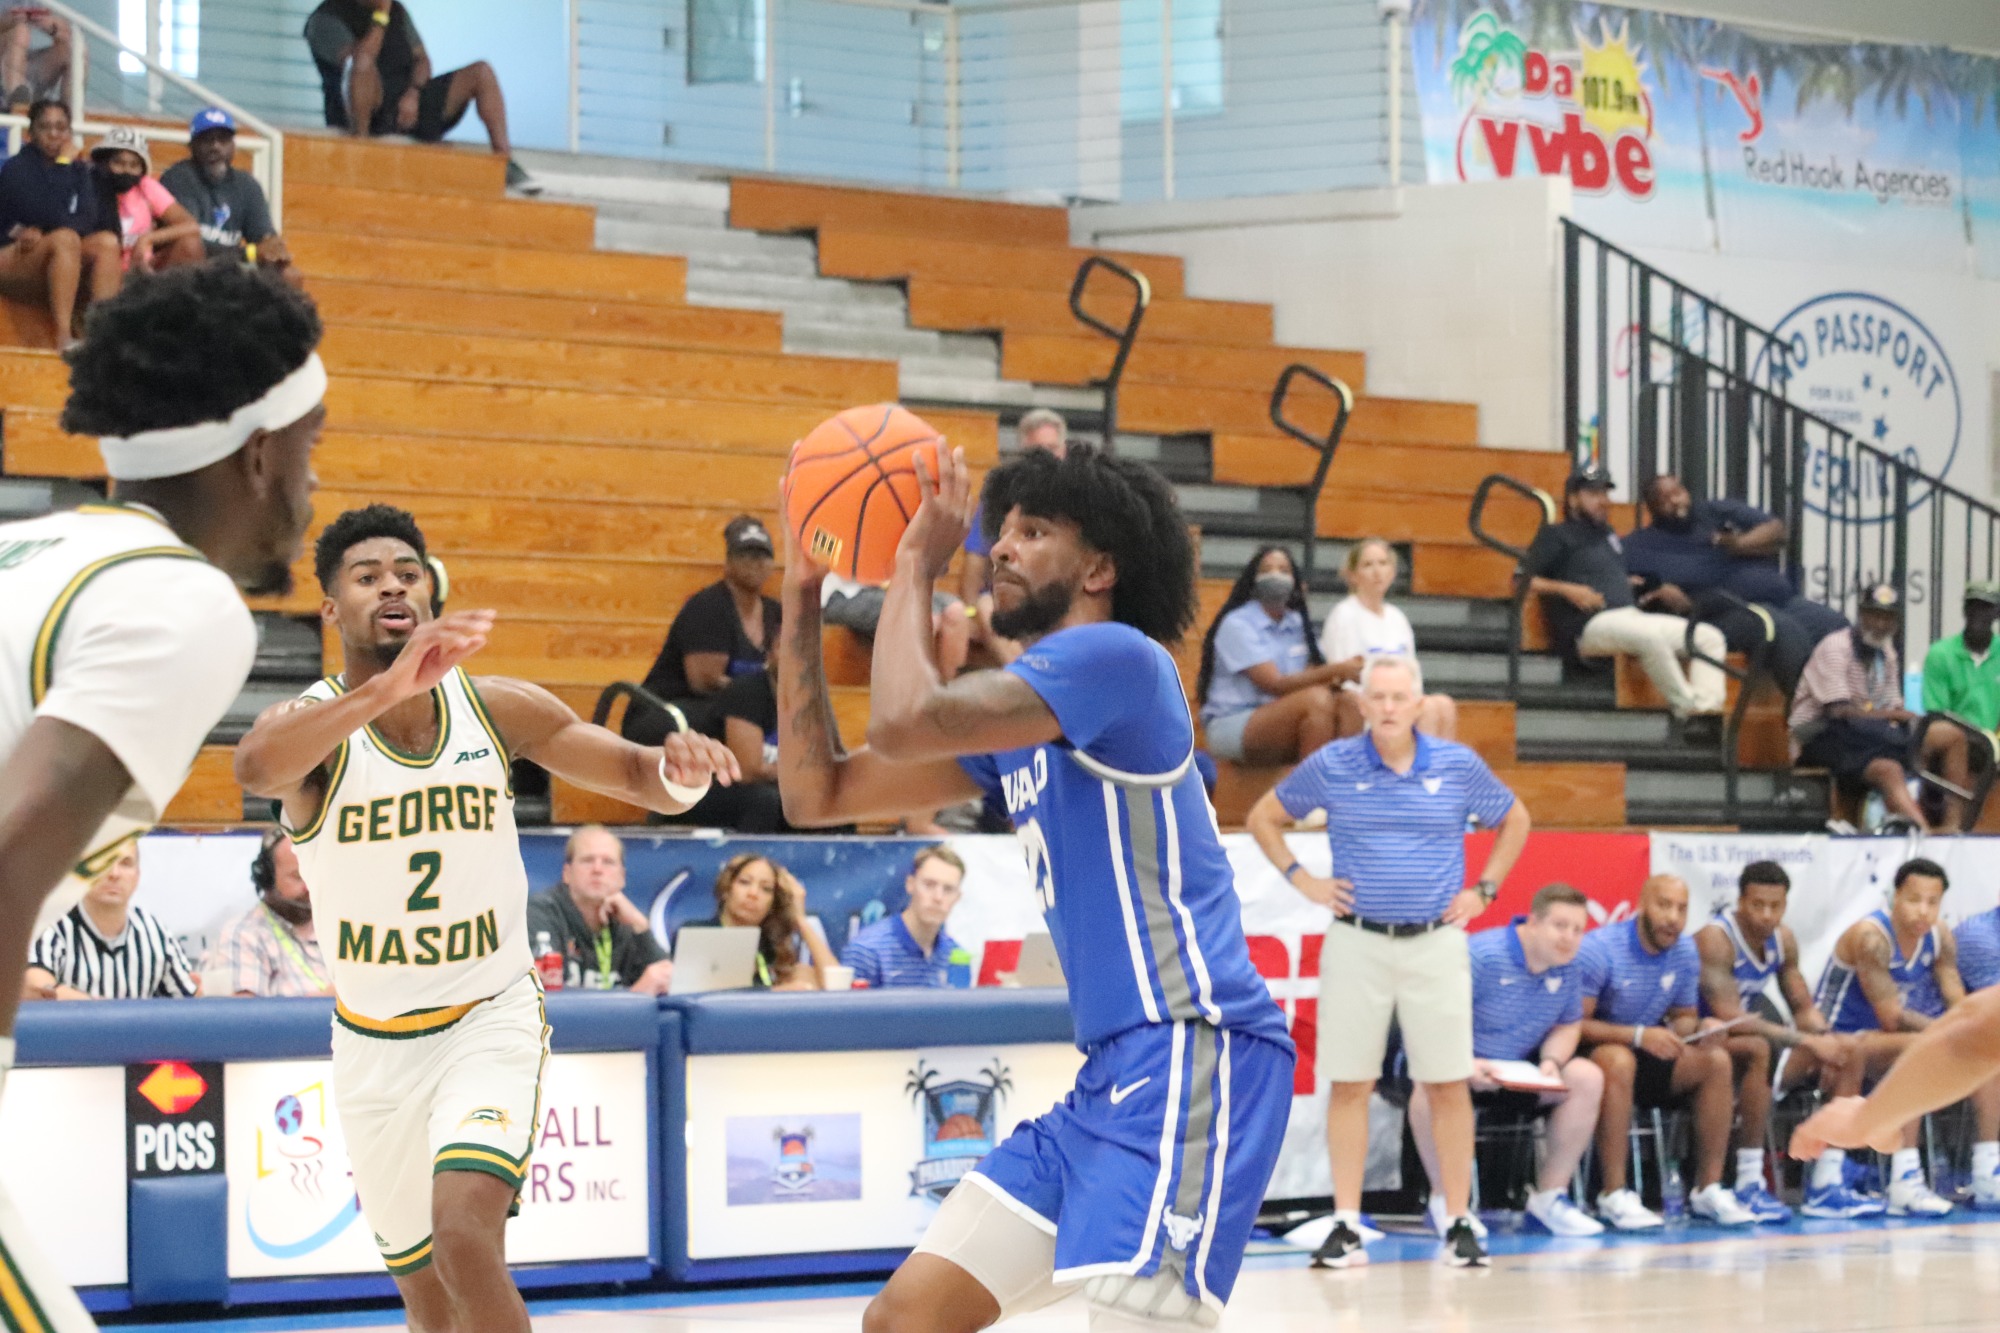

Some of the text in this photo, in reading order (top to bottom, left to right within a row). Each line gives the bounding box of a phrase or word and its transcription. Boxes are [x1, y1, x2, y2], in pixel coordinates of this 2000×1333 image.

[1524, 51, 1574, 98] Da
[1855, 158, 1951, 204] Agencies
[1814, 312, 1946, 400] PASSPORT
[336, 784, 498, 844] GEORGE
[405, 849, 442, 914] 2
[337, 907, 499, 966] MASON
[134, 1121, 216, 1171] POSS
[540, 1105, 612, 1148] ALL
[531, 1162, 627, 1203] RS INC.
